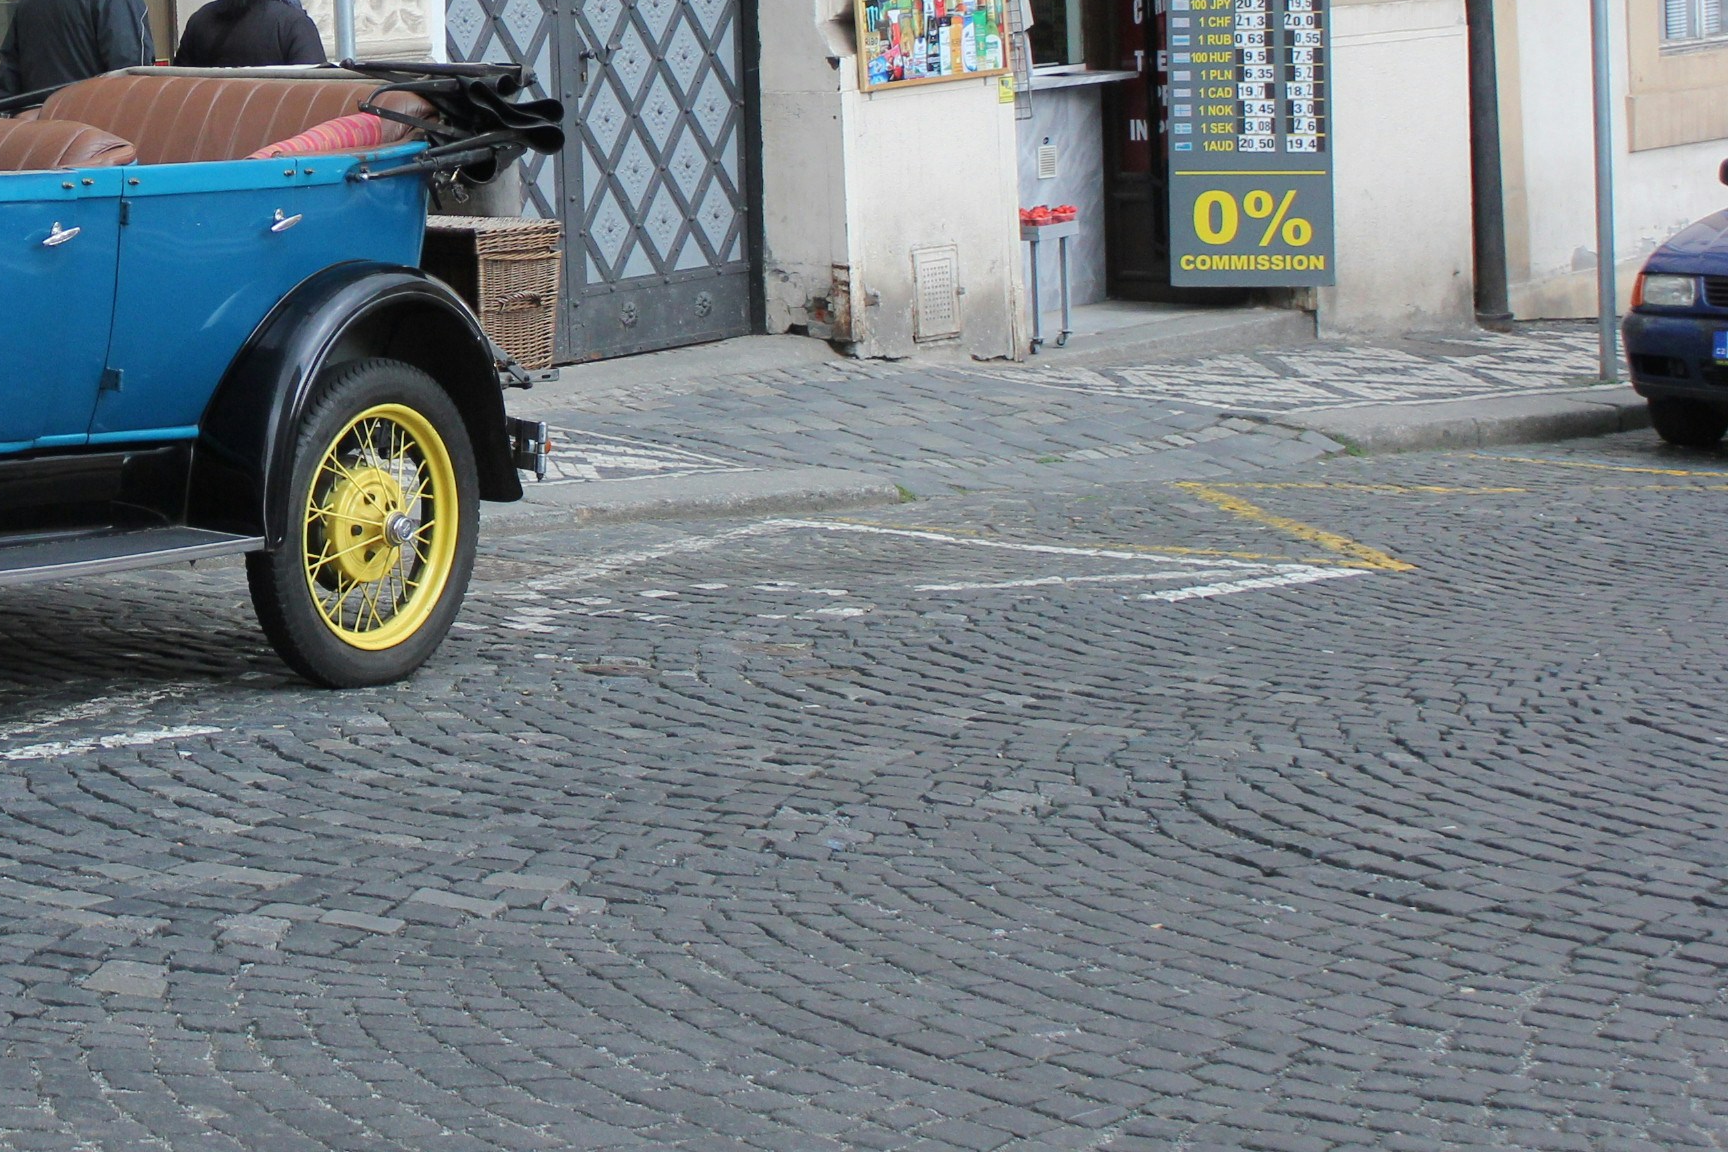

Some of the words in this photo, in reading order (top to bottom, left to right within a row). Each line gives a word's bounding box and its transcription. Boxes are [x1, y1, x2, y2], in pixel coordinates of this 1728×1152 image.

[1191, 0, 1207, 9] 100
[1210, 0, 1231, 9] JPY
[1199, 17, 1204, 27] 1
[1208, 17, 1231, 27] CHF
[1198, 35, 1204, 45] 1
[1207, 35, 1232, 45] RUB
[1191, 53, 1208, 63] 100
[1209, 52, 1232, 62] HUF
[1201, 70, 1206, 80] 1
[1210, 70, 1232, 80] PLN
[1199, 88, 1204, 98] 1
[1208, 88, 1232, 98] CAD
[1199, 106, 1204, 116] 1
[1208, 105, 1233, 116] NOK
[1201, 124, 1206, 133] 1
[1210, 123, 1234, 133] SEK
[1193, 189, 1313, 247] 0%
[1180, 254, 1325, 271] COMMISSION
